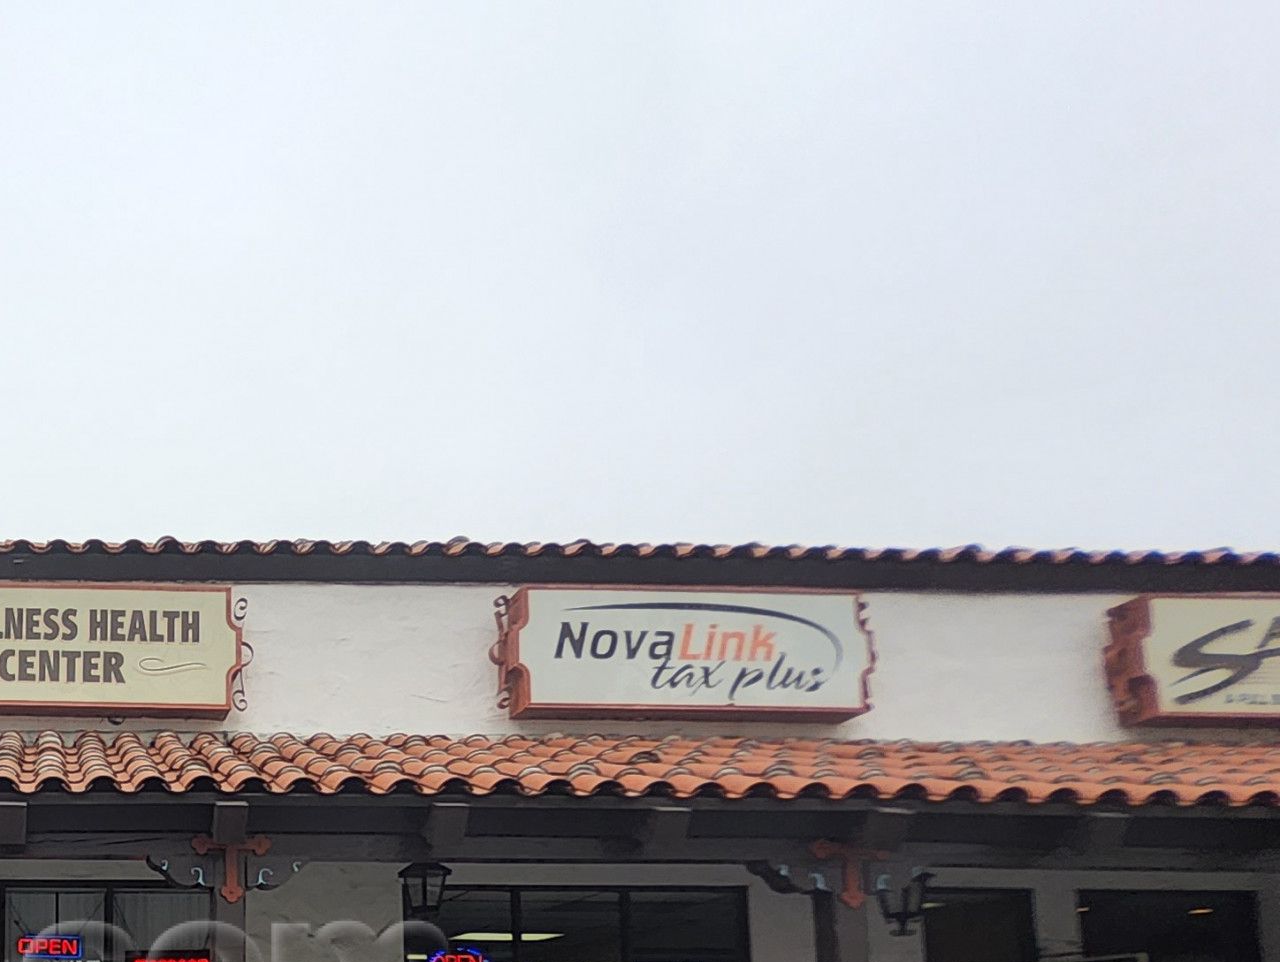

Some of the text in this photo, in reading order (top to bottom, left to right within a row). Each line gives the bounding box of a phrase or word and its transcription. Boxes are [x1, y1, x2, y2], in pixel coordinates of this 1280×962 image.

[89, 608, 201, 643] HEALTH
[553, 621, 778, 662] NovaLink
[650, 651, 826, 704] tax plus
[17, 936, 79, 956] OPEN
